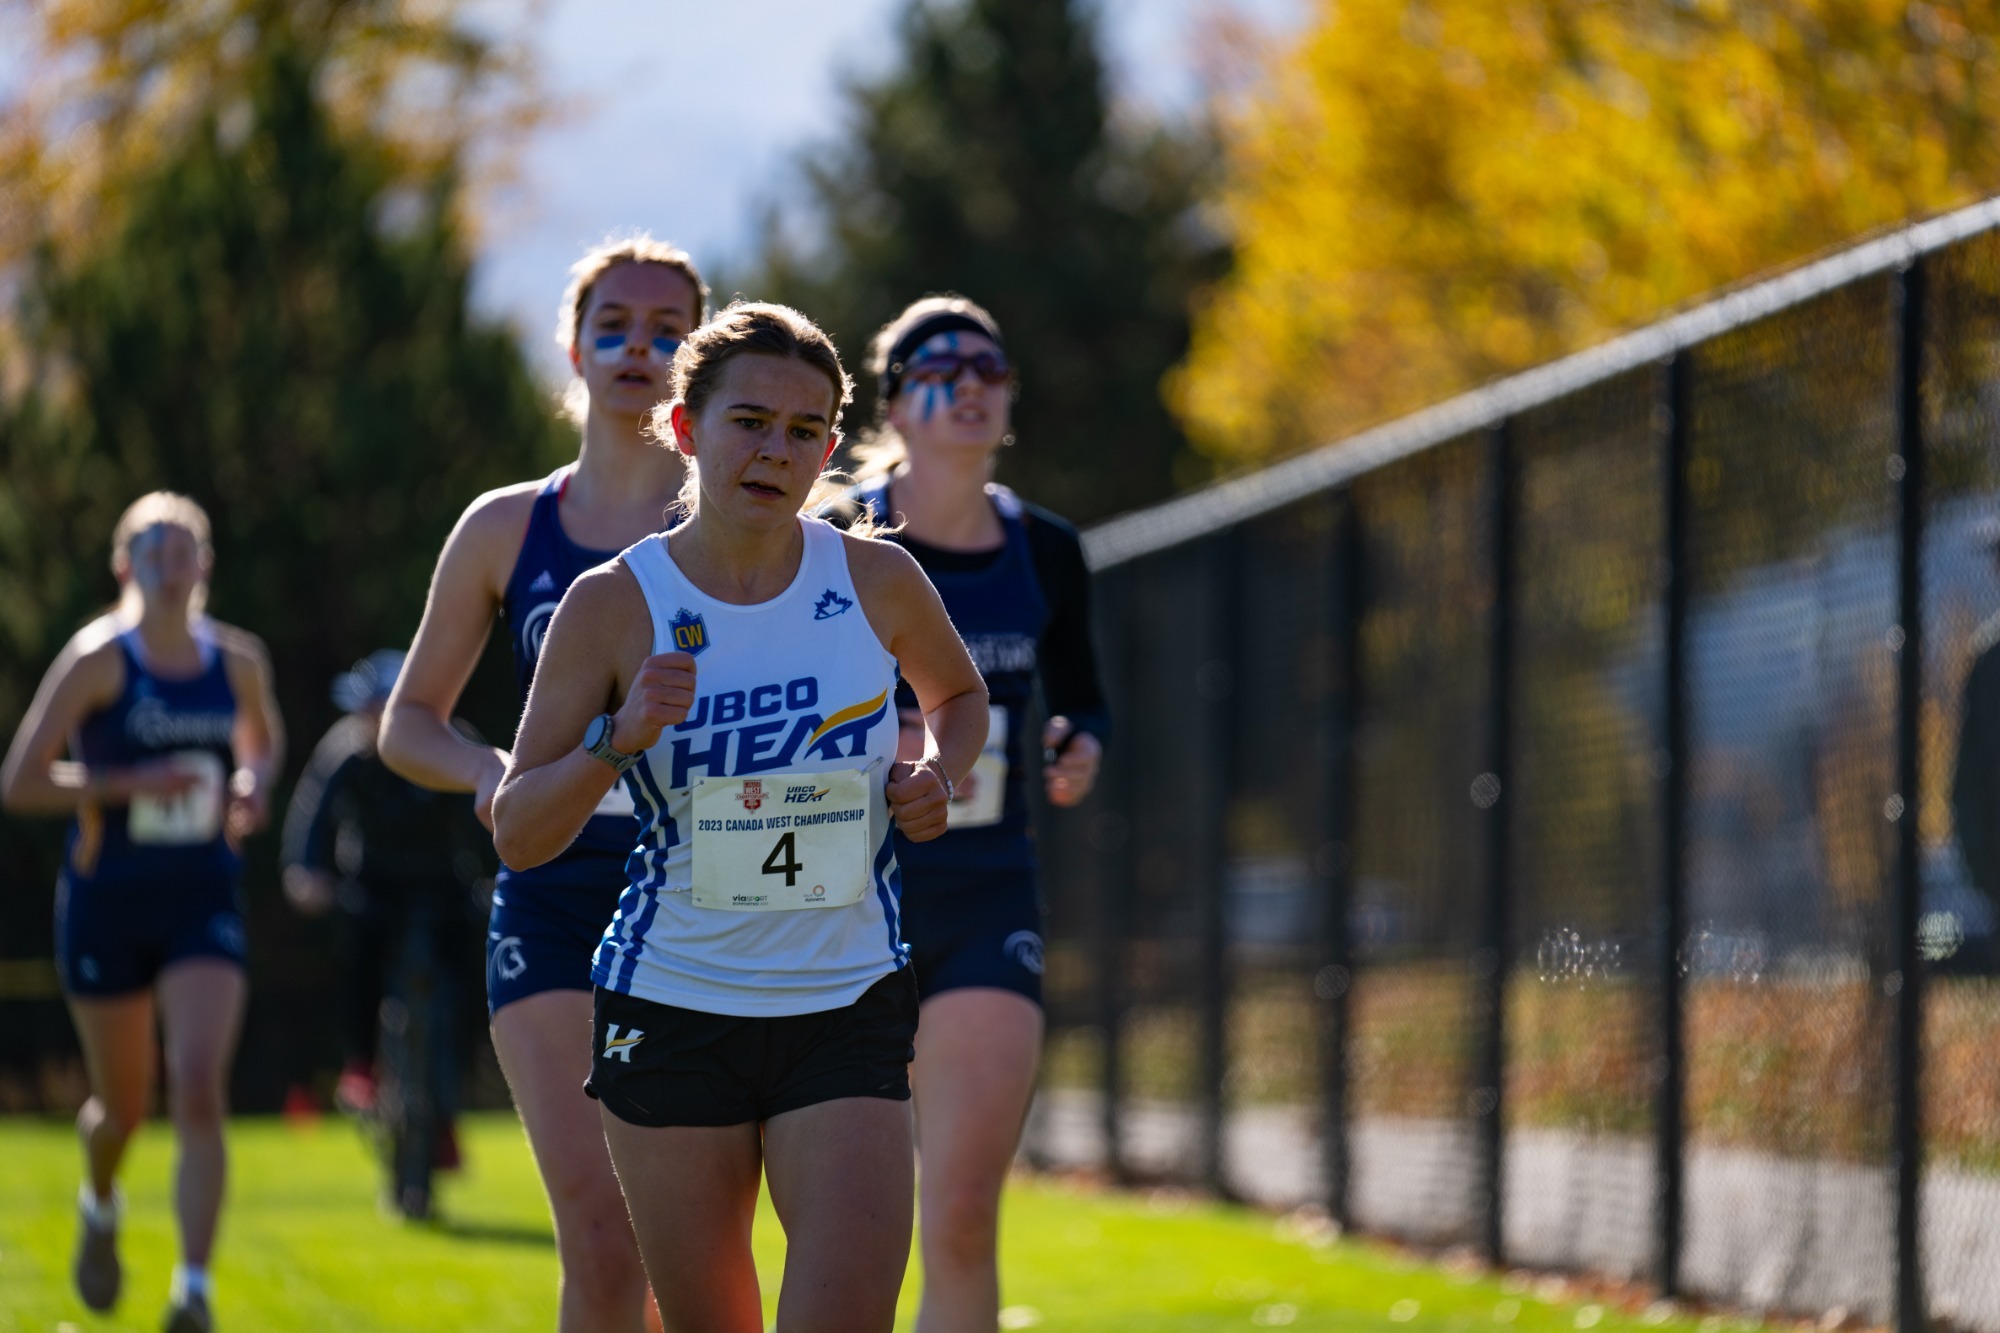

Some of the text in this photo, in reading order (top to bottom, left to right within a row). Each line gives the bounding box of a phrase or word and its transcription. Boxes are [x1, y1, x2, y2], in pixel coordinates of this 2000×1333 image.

[675, 623, 704, 649] CW
[674, 676, 819, 733] UBCO
[670, 688, 888, 790] HEAT
[784, 788, 831, 803] HEAT
[698, 808, 865, 832] 2023 CANADA WEST CHAMPIONSHIP
[762, 831, 803, 887] 4
